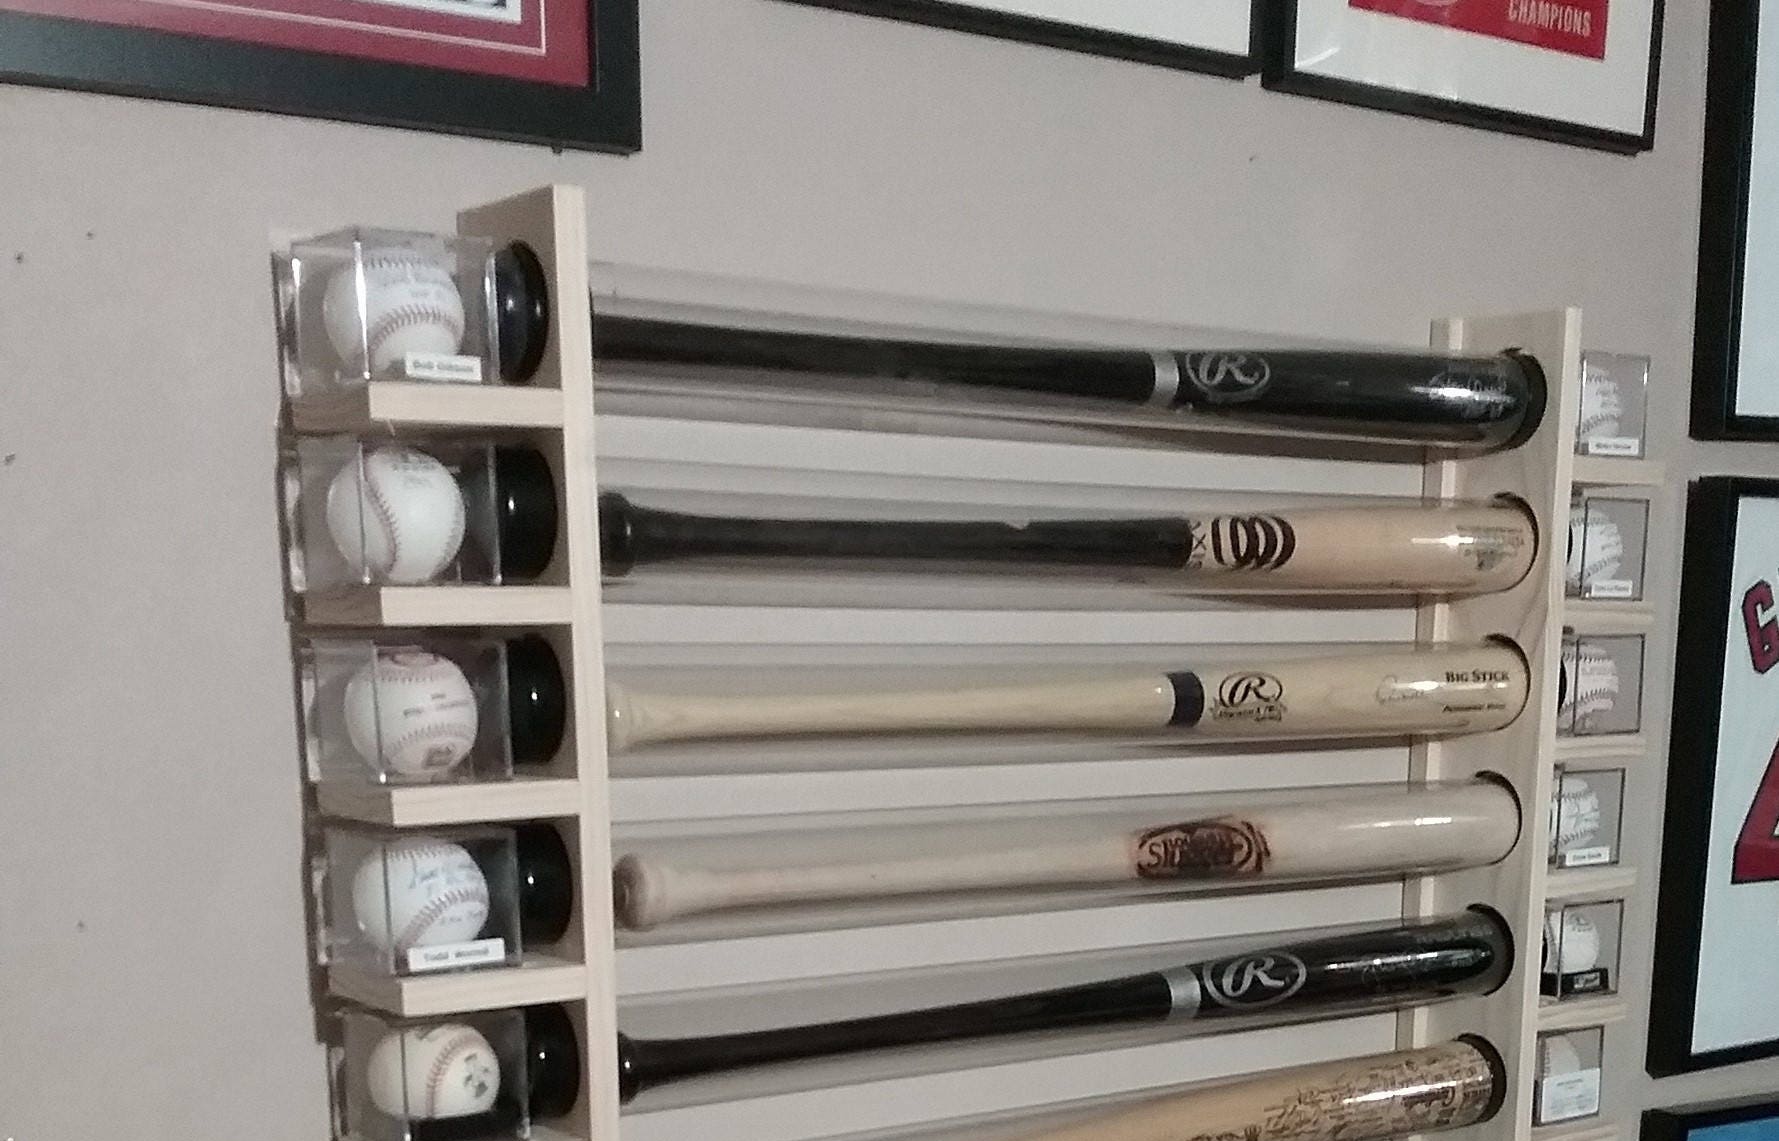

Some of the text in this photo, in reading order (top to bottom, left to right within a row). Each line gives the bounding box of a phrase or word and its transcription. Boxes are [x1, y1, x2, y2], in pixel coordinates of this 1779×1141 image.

[1508, 0, 1591, 37] CHAMPIONS
[1445, 668, 1510, 682] BIG STICK
